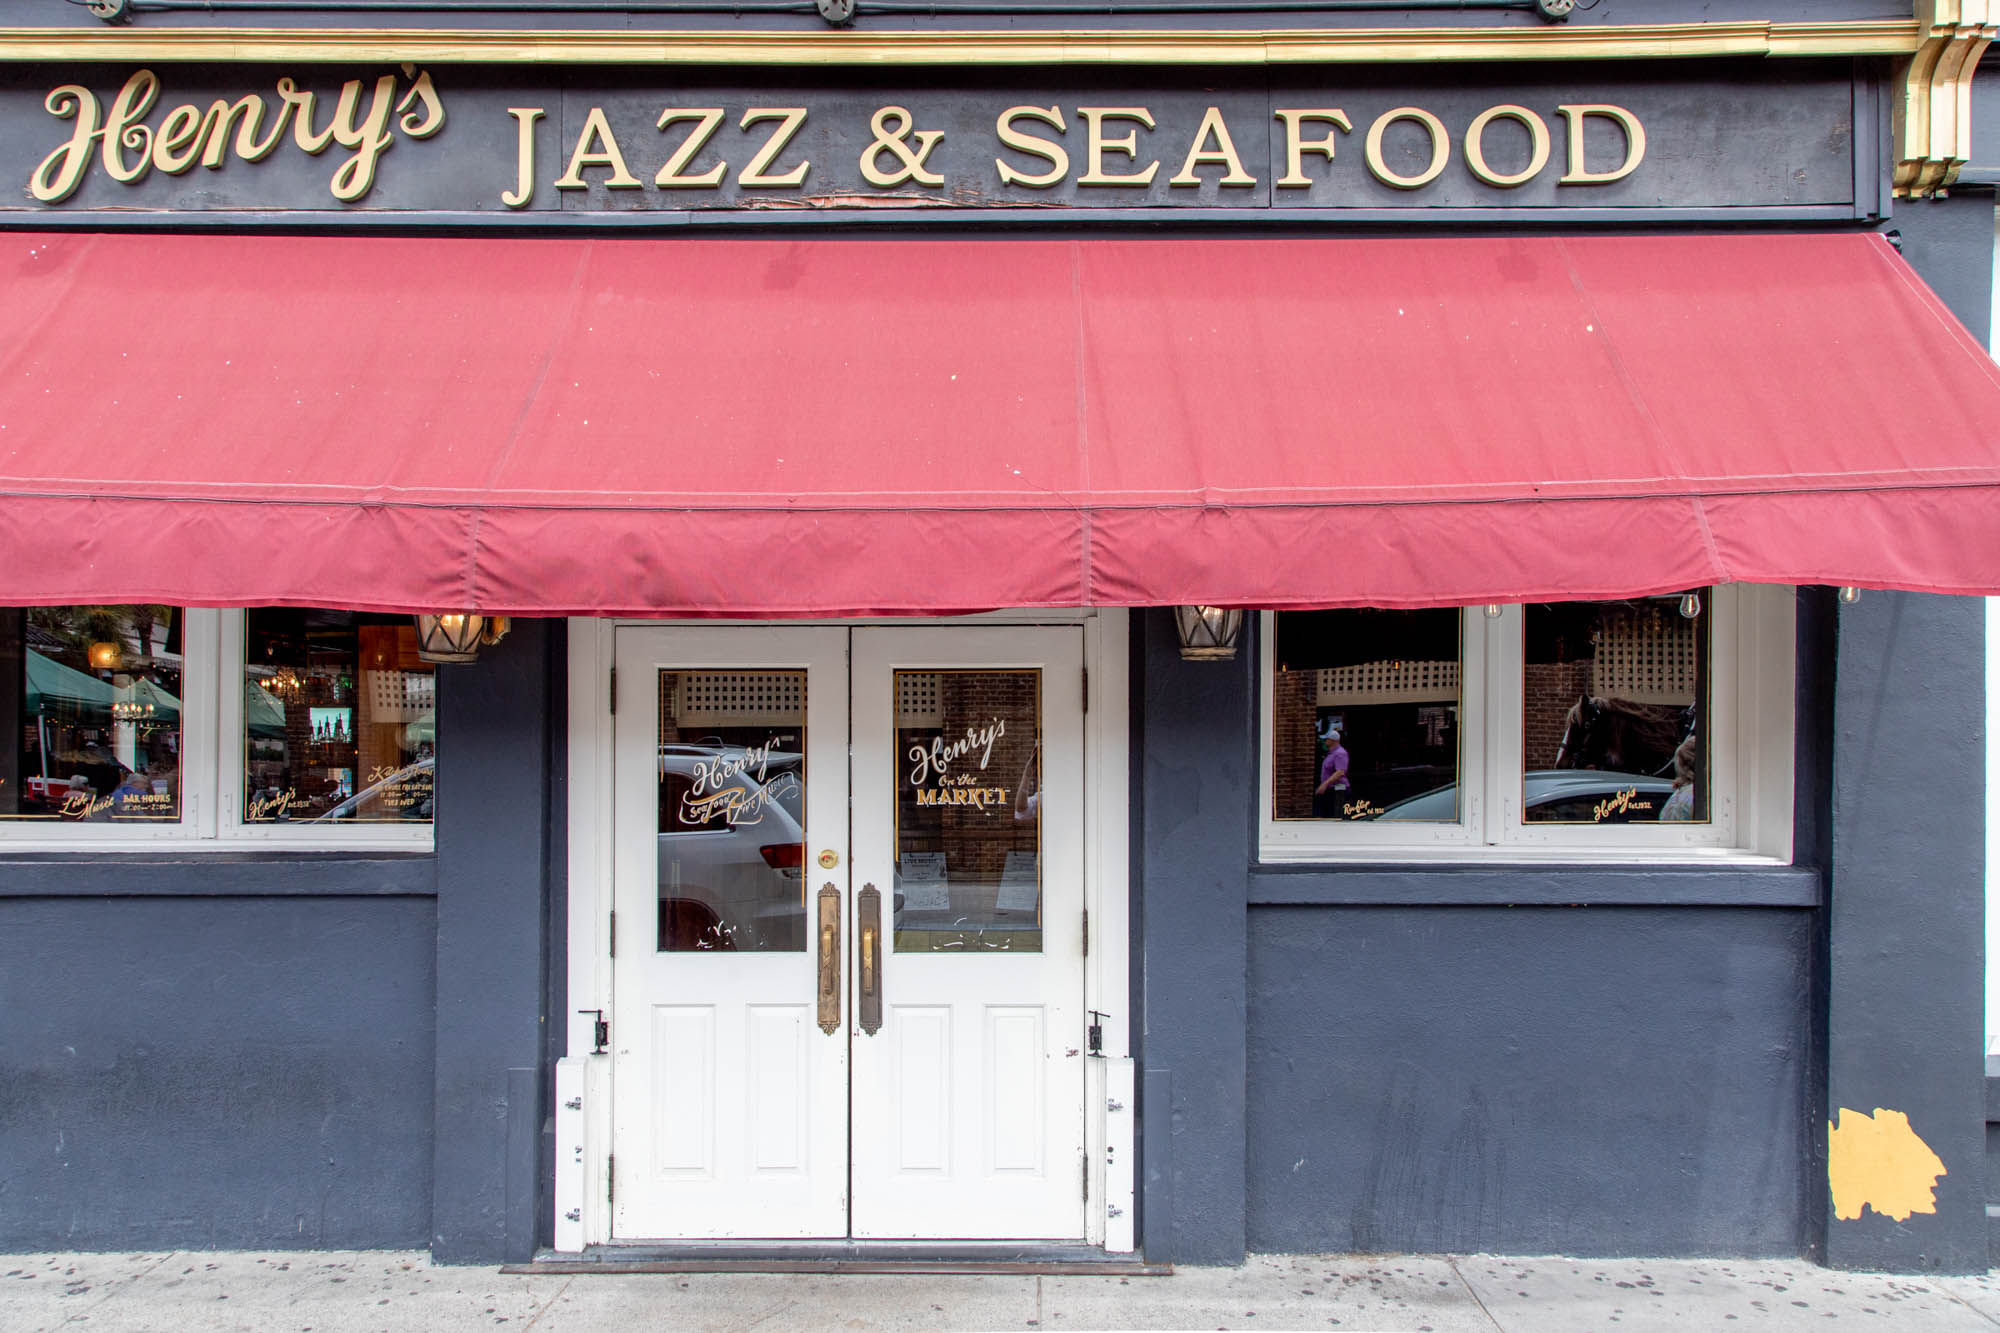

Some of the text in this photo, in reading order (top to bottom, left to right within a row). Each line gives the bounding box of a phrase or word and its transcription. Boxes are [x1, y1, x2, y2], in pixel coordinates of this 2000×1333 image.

[30, 67, 1647, 208] Henry's JAZZ & SEAFOOD
[909, 717, 1005, 785] Henry's
[938, 773, 977, 787] On the
[59, 792, 115, 820] Live Music
[122, 793, 171, 804] BAR HOURS
[248, 787, 297, 821] Henry's
[916, 787, 1011, 810] MARKET
[1593, 784, 1637, 821] Henry's
